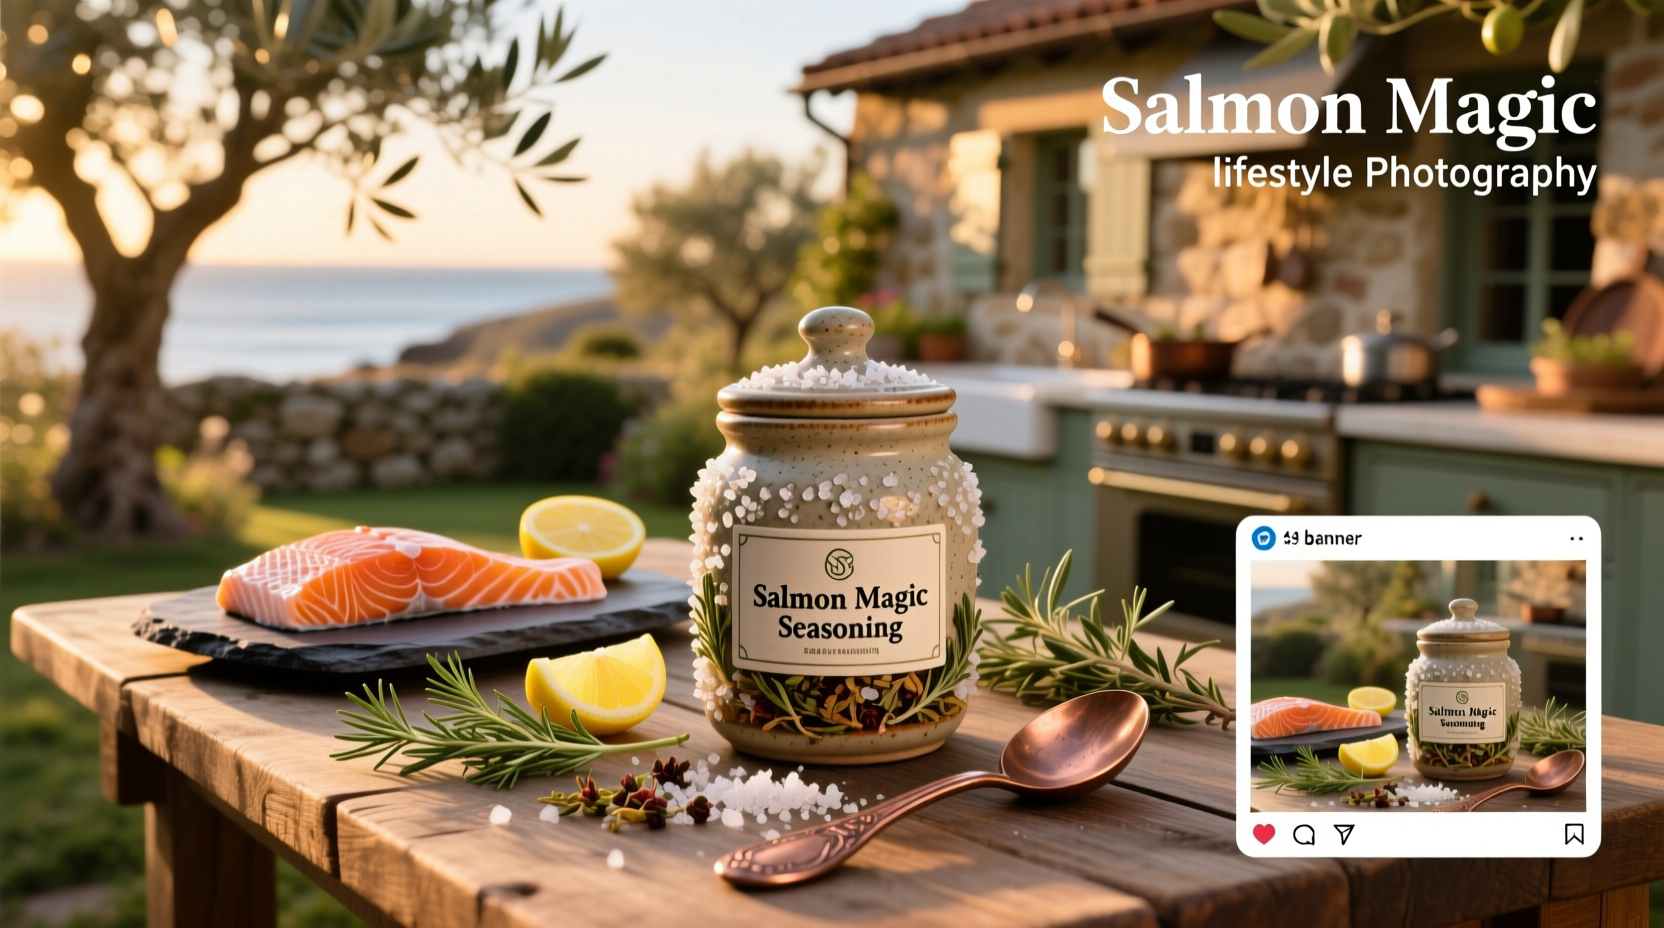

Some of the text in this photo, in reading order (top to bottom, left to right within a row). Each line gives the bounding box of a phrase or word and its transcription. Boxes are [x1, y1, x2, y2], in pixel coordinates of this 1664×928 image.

[753, 583, 929, 615] Salmon Magic
[778, 615, 904, 644] Seasoning
